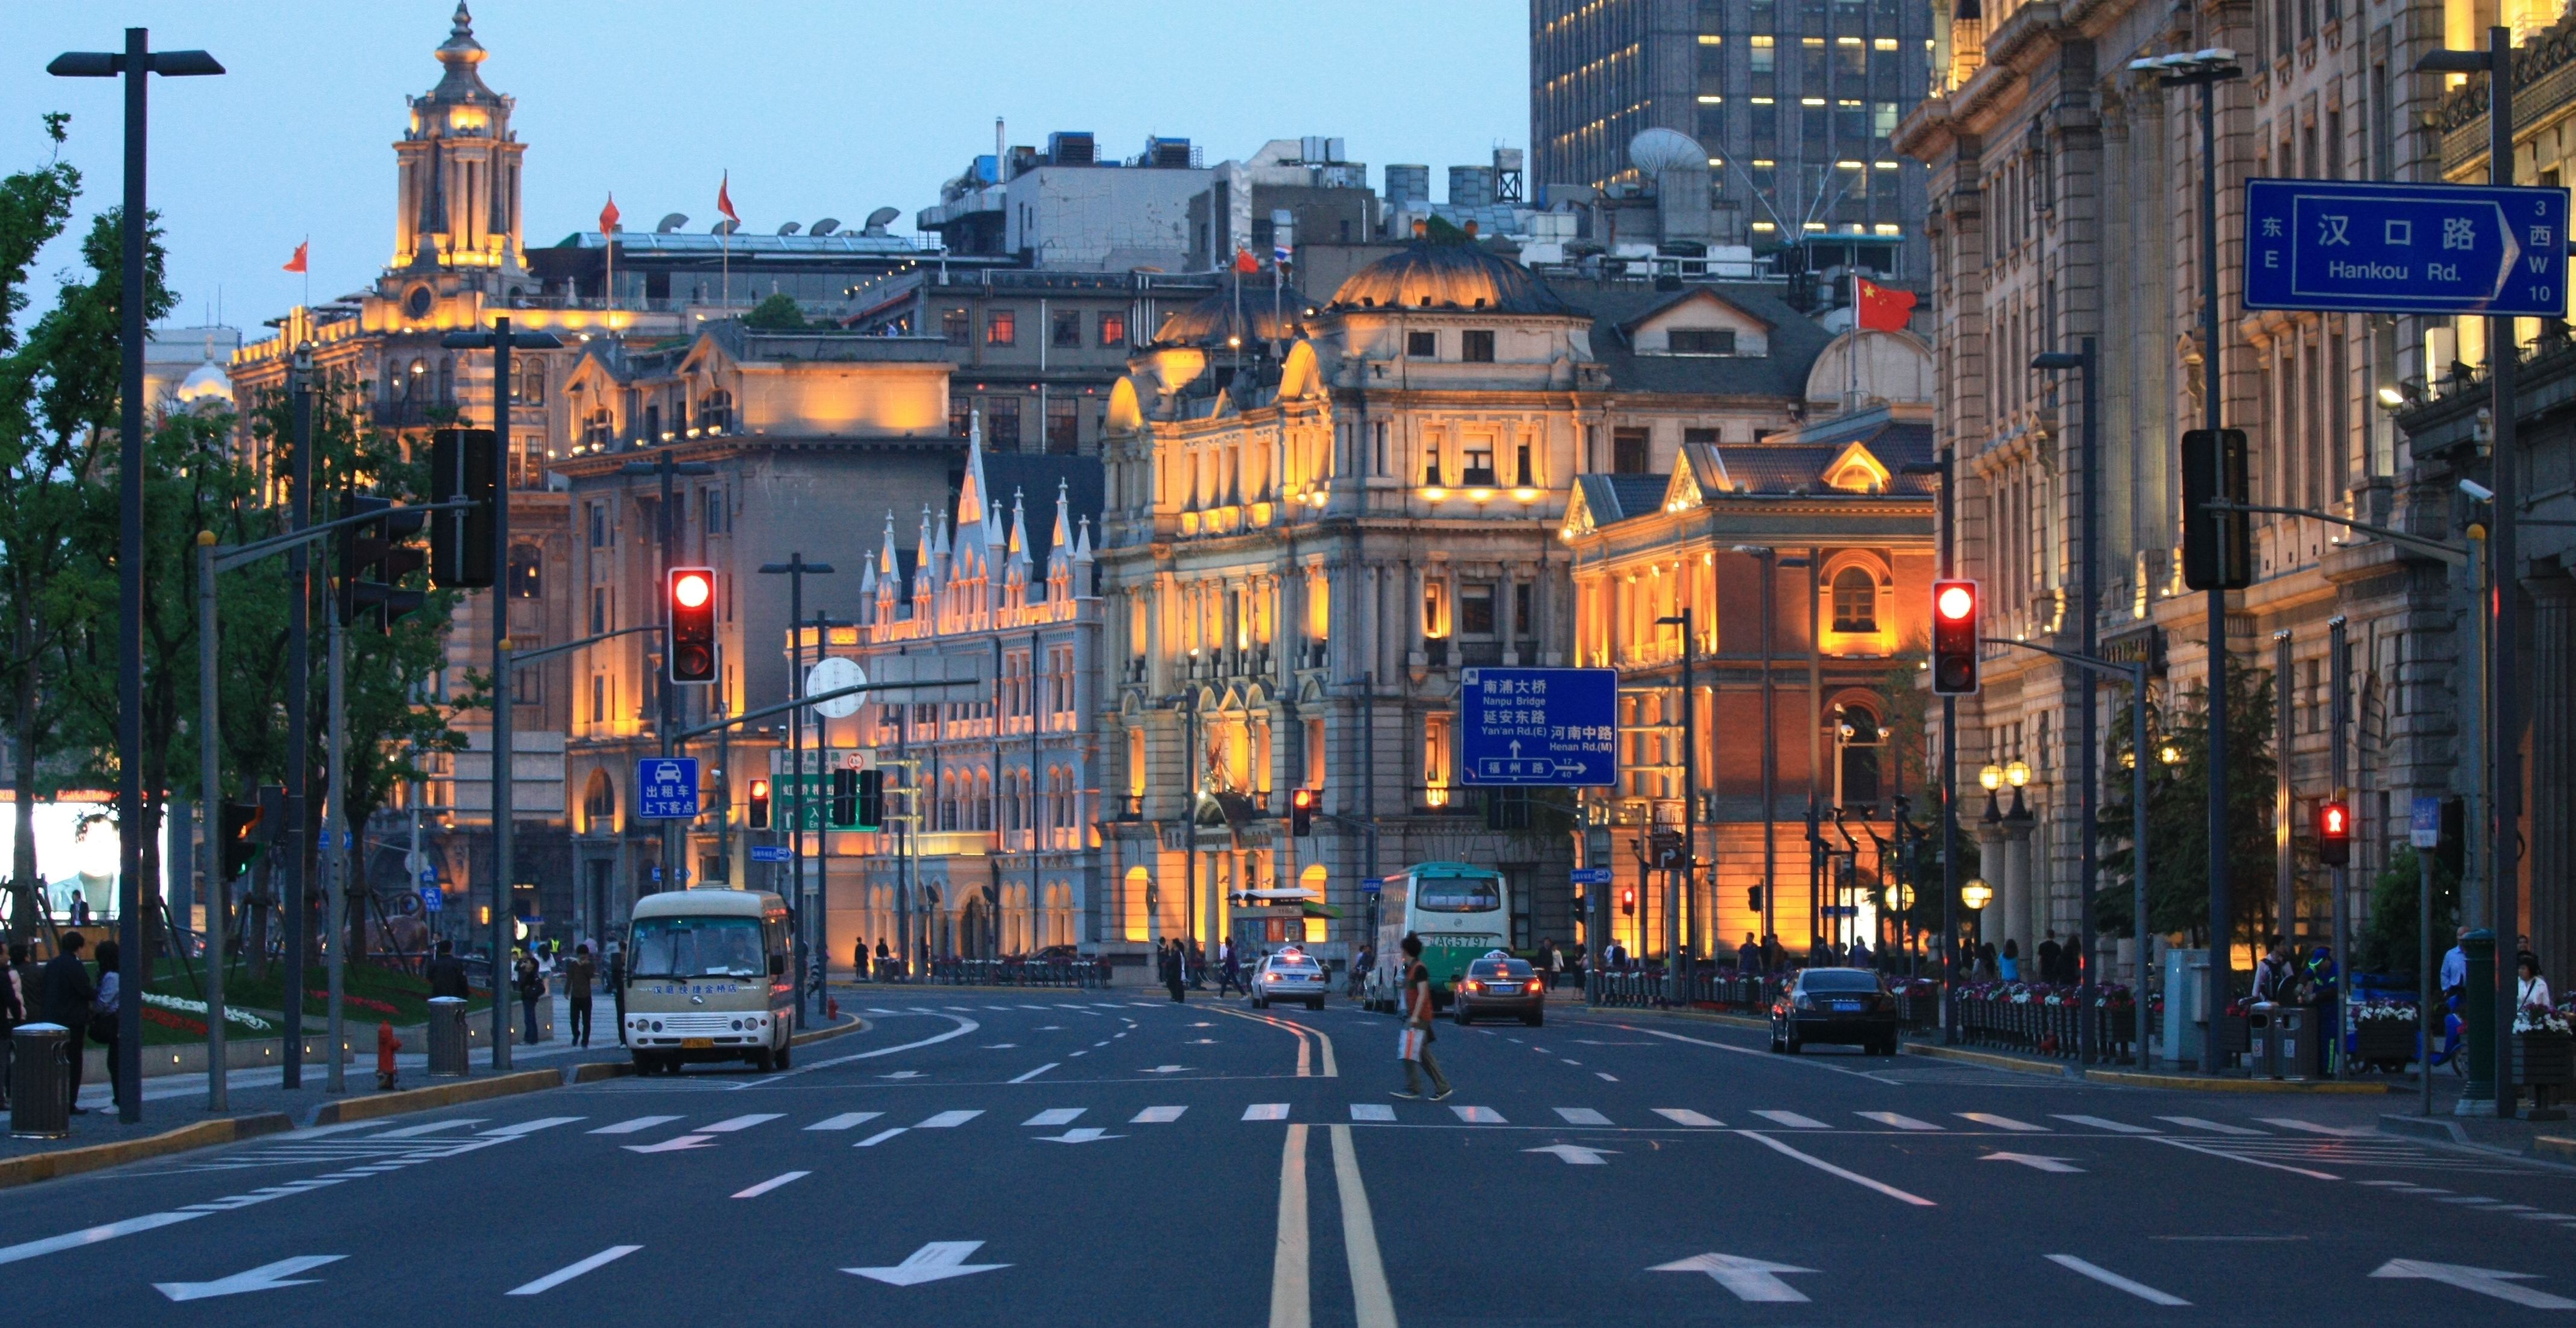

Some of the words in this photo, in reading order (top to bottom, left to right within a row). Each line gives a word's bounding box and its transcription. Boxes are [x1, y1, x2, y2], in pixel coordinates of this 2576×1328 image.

[2535, 201, 2546, 216] 3
[2262, 217, 2282, 237] 东
[2318, 214, 2475, 250] 汉口路
[2530, 225, 2551, 247] 西
[2265, 251, 2278, 268] E
[2528, 256, 2548, 273] W
[2329, 261, 2408, 280] Hankou
[2428, 262, 2461, 281] Rd.
[2530, 286, 2550, 301] 10
[1483, 679, 1546, 694] 南浦大桥
[1483, 697, 1512, 706] Nanpu
[1517, 696, 1545, 707] Bridge
[1483, 710, 1545, 724] 延安东路
[1482, 726, 1514, 735] Yan'an
[1517, 726, 1547, 737] Rd.(E)
[1551, 726, 1612, 740] 河南中路
[1550, 742, 1579, 751] Henan
[1582, 742, 1612, 753] Rd.(M)
[1489, 762, 1544, 774] 福州路
[646, 785, 689, 798] 出租车
[642, 801, 695, 814] 上下客点
